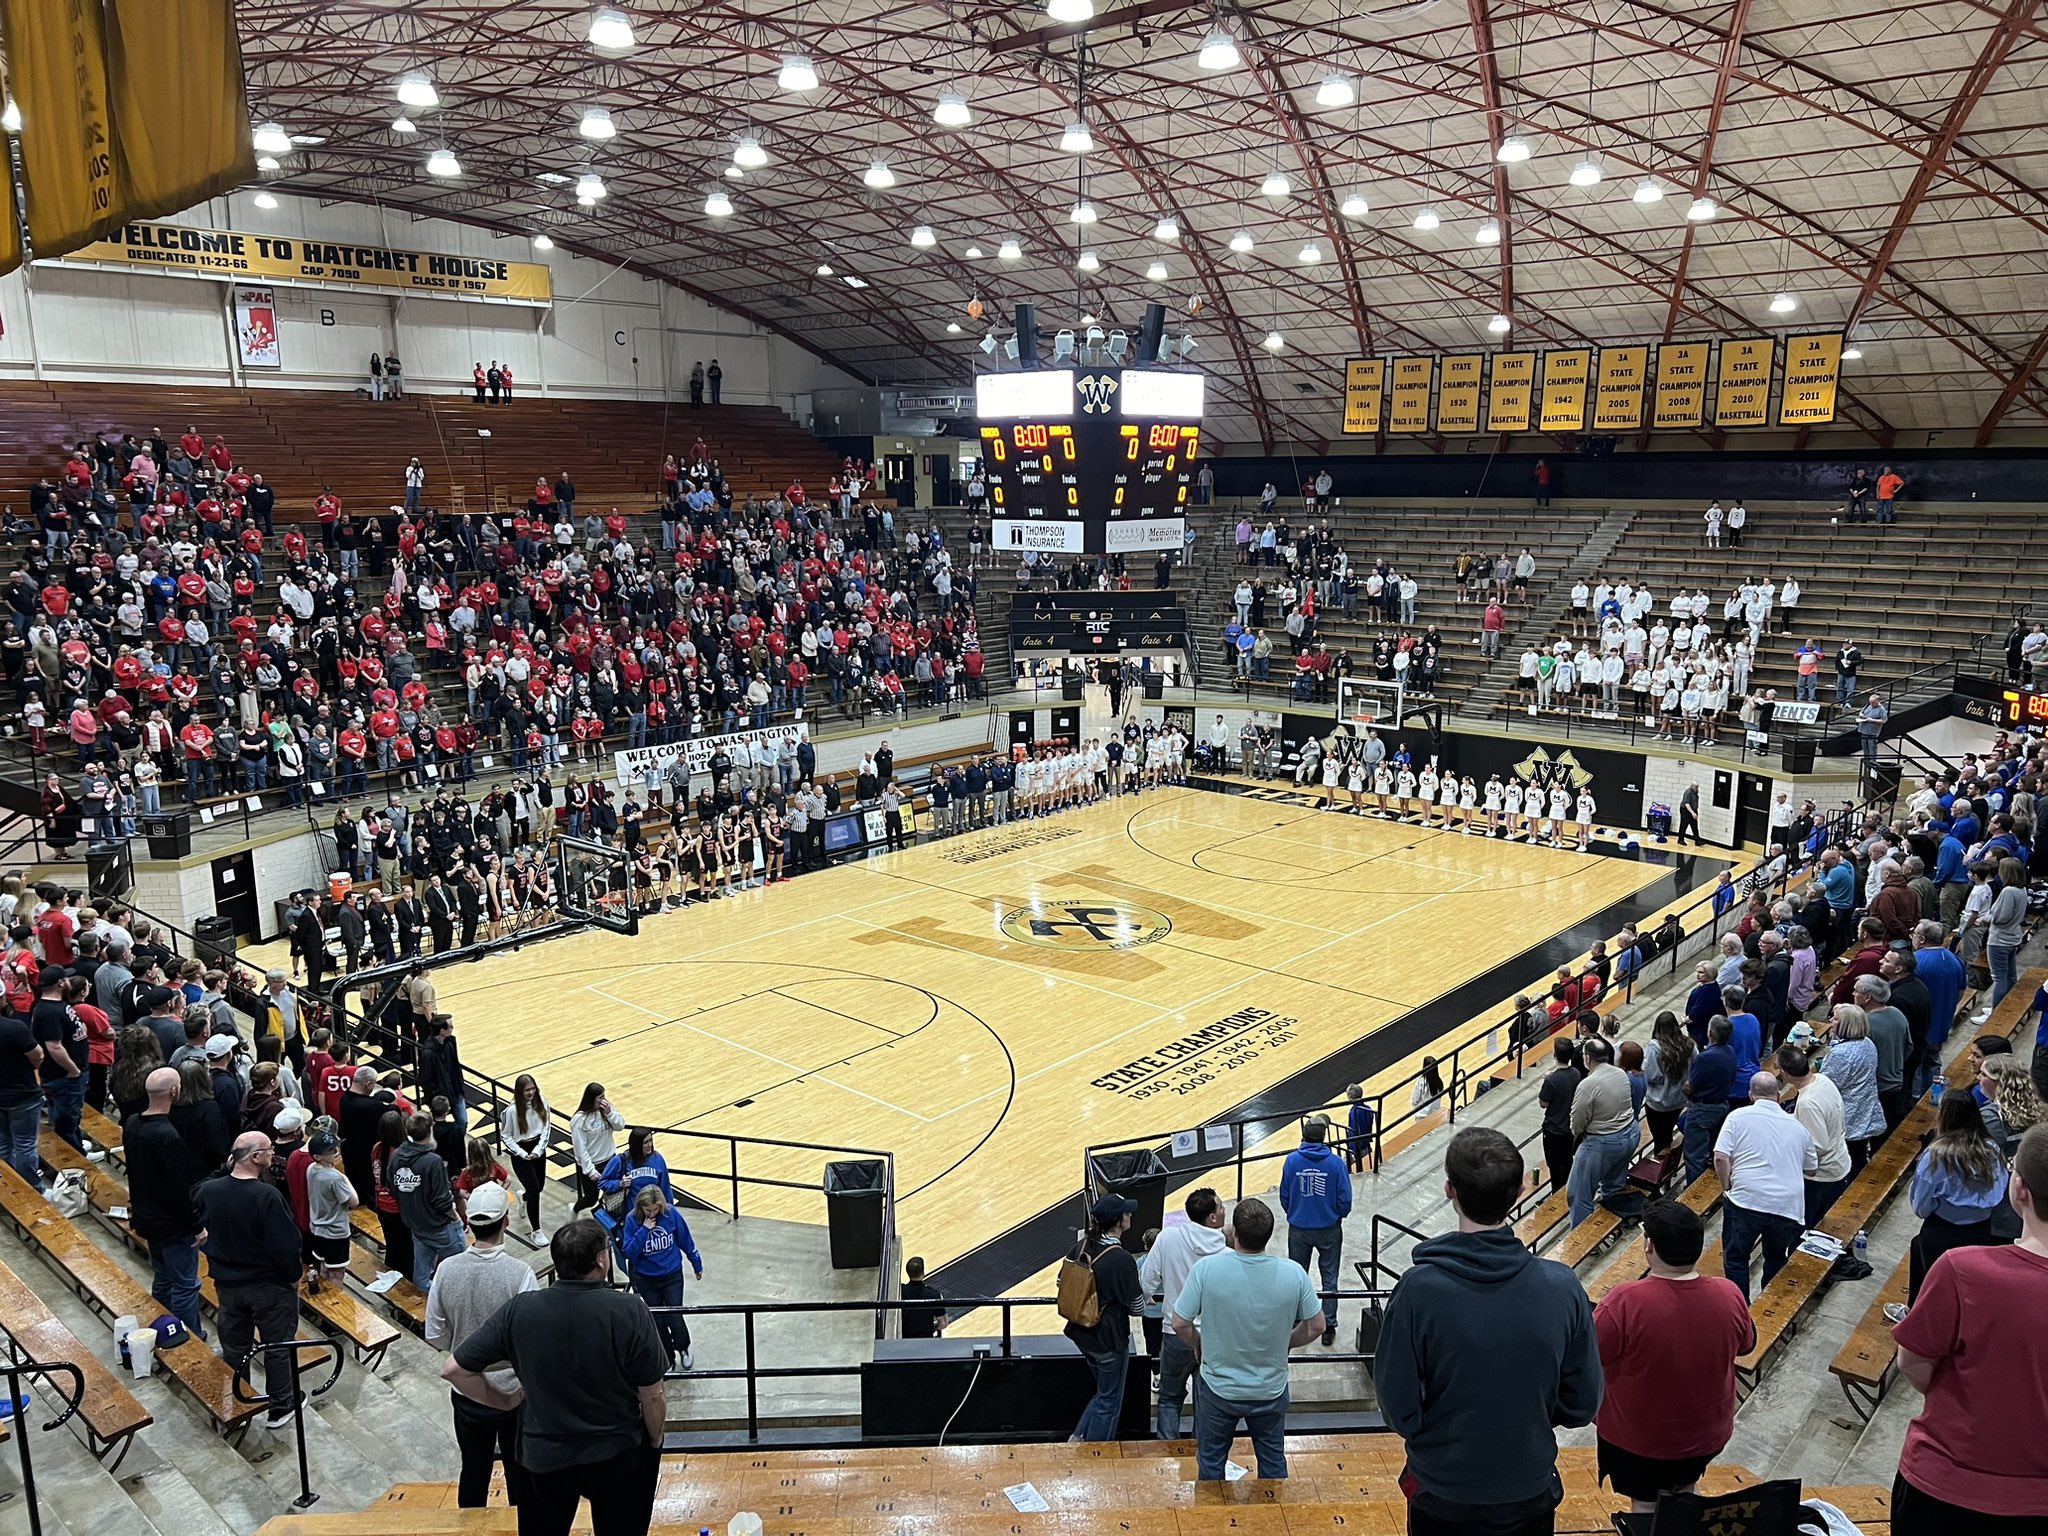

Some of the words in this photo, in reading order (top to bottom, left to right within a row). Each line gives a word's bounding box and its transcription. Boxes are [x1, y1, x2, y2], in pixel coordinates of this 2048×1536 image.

[102, 225, 245, 256] WELCOME
[255, 238, 292, 260] TO
[302, 243, 419, 272] HATCHET
[429, 256, 508, 280] HOUSE
[128, 249, 196, 264] DEDICATED
[200, 256, 248, 269] 11-23-66
[301, 266, 328, 277] CAP.
[331, 268, 360, 280] 7090
[412, 276, 445, 288] CLASS
[448, 279, 462, 288] OF
[463, 280, 486, 290] 1967
[321, 309, 336, 326] B
[614, 331, 626, 346] C
[1741, 346, 1753, 355] 3A
[1808, 342, 1820, 350] 3A
[1618, 354, 1628, 362] 3A
[1678, 351, 1688, 359] 3A
[1556, 358, 1578, 367] STATE
[1733, 362, 1758, 371] STATE
[1799, 358, 1826, 368] STATE
[1356, 366, 1374, 374] STATE
[1610, 368, 1633, 377] STATE
[1670, 366, 1694, 374] STATE
[1494, 378, 1530, 387] CHAMPION
[1547, 377, 1584, 386] CHAMPION
[1722, 378, 1767, 388] CHAMPION
[1788, 374, 1834, 384] CHAMPION
[1349, 383, 1380, 391] CHAMPION
[1395, 382, 1428, 390] CHAMPION
[1600, 383, 1640, 392] CHAMPION
[1660, 381, 1702, 391] CHAMPION
[1554, 396, 1572, 404] 1942
[1732, 395, 1753, 404] 2010
[1799, 392, 1820, 401] 2011
[1608, 400, 1630, 408] 2005
[1668, 398, 1690, 406] 2008
[1543, 414, 1580, 422] BASKETBALL
[1657, 413, 1699, 422] BASKETBALL
[1719, 410, 1763, 420] BASKETBALL
[1785, 408, 1830, 418] BASKETBALL
[1441, 416, 1474, 424] BASKETBALL
[1491, 415, 1526, 423] BASKETBALL
[1597, 414, 1638, 423] BASKETBALL
[1013, 424, 1048, 446] 8:00
[1149, 424, 1179, 446] 8:00
[1926, 431, 1943, 447] F
[994, 439, 1006, 460] 0
[1063, 438, 1075, 460] 0
[1127, 438, 1139, 460] 0
[1186, 438, 1197, 459] 0
[1466, 440, 1480, 452] E
[1020, 459, 1039, 470] period
[1043, 455, 1052, 471] 0
[1147, 459, 1164, 469] period
[1166, 454, 1175, 471] 0
[1022, 474, 1040, 484] player
[1145, 474, 1161, 484] player
[994, 486, 1004, 503] 0
[1068, 488, 1077, 504] 0
[1115, 487, 1124, 504] 0
[1178, 486, 1186, 502] 0
[1026, 526, 1065, 536] THOMPSON
[1150, 528, 1181, 537] Memories
[1025, 538, 1065, 548] INSURANCE
[1034, 612, 1162, 620] MEDIA
[1086, 622, 1110, 631] RTC
[1023, 636, 1043, 646] Gate
[1047, 635, 1054, 645] 4
[1141, 634, 1161, 645] Gate
[1166, 634, 1173, 644] 4
[1965, 700, 1985, 717] Gate
[2028, 696, 2048, 716] 8:0
[2010, 703, 2020, 720] 0
[626, 742, 695, 763] WELCOME
[700, 739, 715, 750] TO
[688, 751, 711, 762] HOST
[1090, 1056, 1168, 1092] STATE
[1155, 1007, 1272, 1060] CHAMPIONS
[1128, 1079, 1170, 1100] 1930
[1176, 1059, 1213, 1079] 1941
[1217, 1038, 1256, 1058] 1942
[1259, 1017, 1298, 1036] 2005
[1171, 1073, 1216, 1095] 2008
[1221, 1049, 1259, 1070] 2010
[1264, 1031, 1298, 1049] 2011
[327, 1076, 350, 1091] 50
[631, 1166, 657, 1179] EMORIAL
[167, 1324, 176, 1336] B
[1701, 1501, 1760, 1522] FRY
